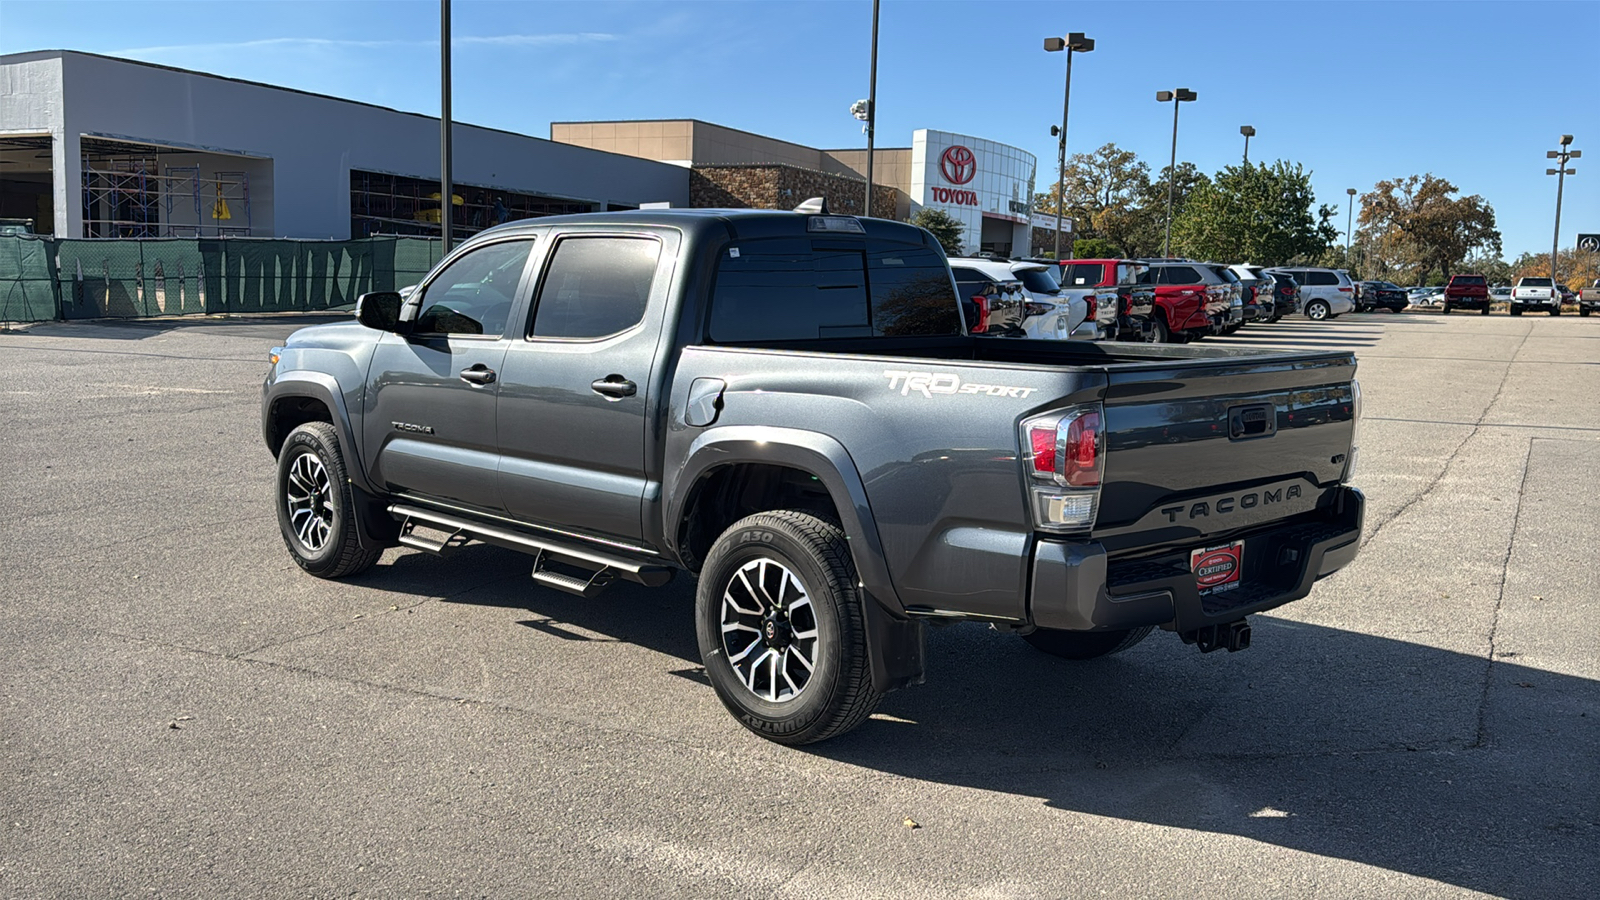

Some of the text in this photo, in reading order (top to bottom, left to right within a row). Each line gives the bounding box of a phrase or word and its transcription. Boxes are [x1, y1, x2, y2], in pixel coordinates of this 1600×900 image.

[931, 186, 978, 206] TOYOTA
[882, 369, 1038, 399] TRD SPORT
[391, 421, 434, 434] TACOMA
[294, 434, 317, 448] OPEN
[1161, 484, 1302, 522] TACOMA
[740, 531, 774, 543] A30
[1198, 562, 1232, 577] CERTIFIED
[741, 709, 815, 733] COUNTRY
